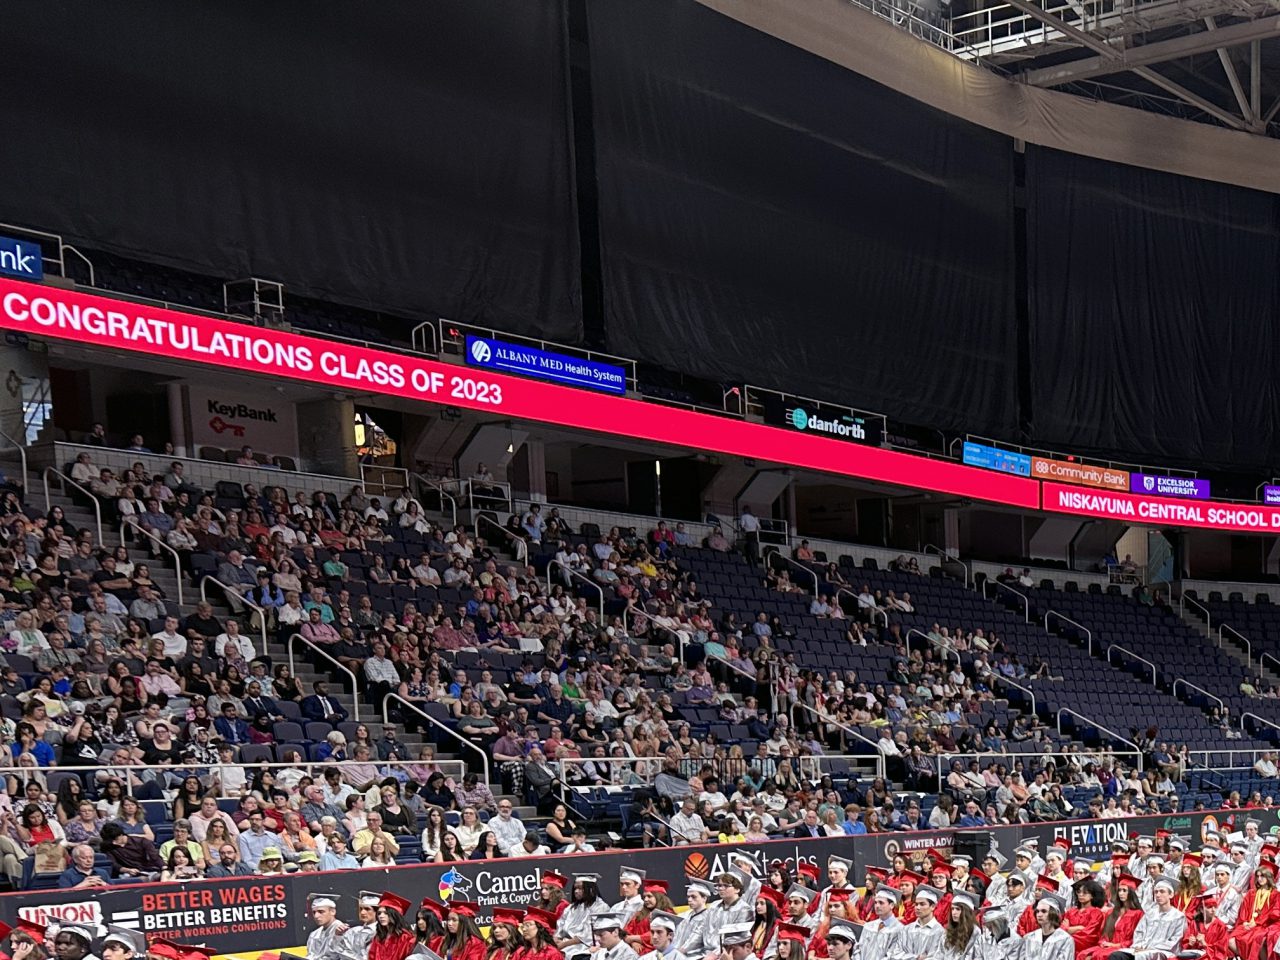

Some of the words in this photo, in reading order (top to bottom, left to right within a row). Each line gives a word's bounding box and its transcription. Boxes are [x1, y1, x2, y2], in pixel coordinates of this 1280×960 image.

[4, 293, 313, 371] CONGRATULATIONS
[320, 352, 404, 387] CLASS
[411, 369, 444, 393] OF
[451, 377, 502, 404] 2023
[496, 350, 537, 366] ALBANY
[540, 357, 563, 371] MED
[565, 362, 592, 377] Health
[593, 371, 622, 383] System
[208, 399, 277, 422] KeyBank
[808, 415, 865, 440] danforth
[1050, 463, 1102, 483] Community
[1104, 472, 1125, 486] Bank
[1158, 478, 1194, 488] EXCELSIOR
[1158, 486, 1198, 496] UNIVERSITY
[1059, 491, 1135, 516] NISKAYUNA
[1138, 502, 1203, 522] CENTRAL
[1208, 508, 1267, 527] SCHOOL
[904, 839, 934, 849] WINTER
[1054, 823, 1127, 846] ELEVATION
[476, 868, 561, 894] Camel
[142, 890, 213, 912] BETTER
[219, 884, 285, 904] WAGES
[478, 895, 498, 906] Print
[500, 894, 507, 905] &
[509, 893, 531, 905] Copy
[25, 904, 95, 926] UNION
[144, 911, 206, 930] BETTER
[210, 903, 287, 924] BENEFITS
[146, 927, 181, 941] BETTER
[185, 924, 228, 938] WORKING
[232, 920, 286, 933] CONDITIONS
